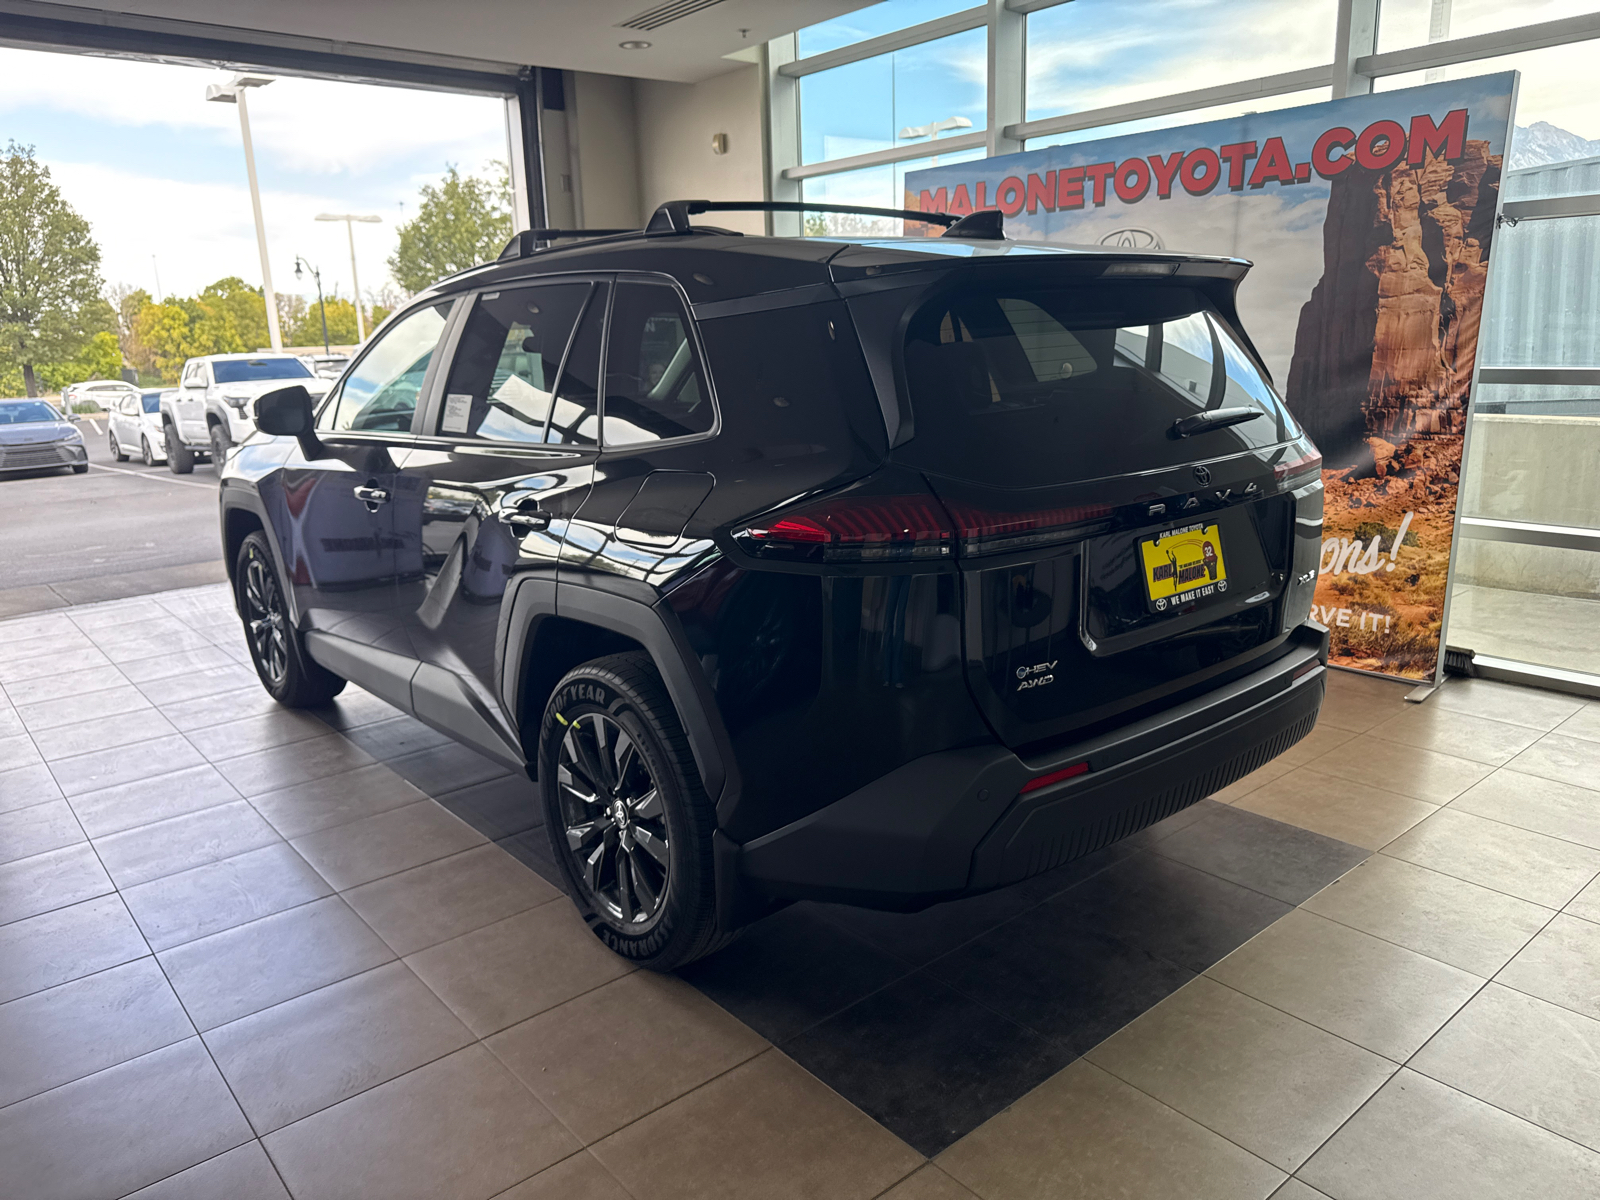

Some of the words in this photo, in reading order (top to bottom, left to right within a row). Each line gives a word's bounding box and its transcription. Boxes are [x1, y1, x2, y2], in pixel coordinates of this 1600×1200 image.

[919, 107, 1470, 219] MALONETOYOTA.COM
[1149, 482, 1257, 516] RAV4
[1159, 531, 1171, 539] KARL
[1171, 526, 1189, 537] MALONE
[1189, 522, 1204, 532] TOYOTA
[1204, 546, 1214, 557] 32
[1153, 563, 1175, 582] KARL
[1178, 564, 1206, 584] MALONE
[1170, 595, 1180, 606] WE
[1180, 590, 1196, 603] MAKE
[1195, 588, 1202, 598] IT
[1201, 585, 1215, 596] EASY
[1360, 612, 1391, 634] IT!
[1017, 674, 1054, 691] AWD
